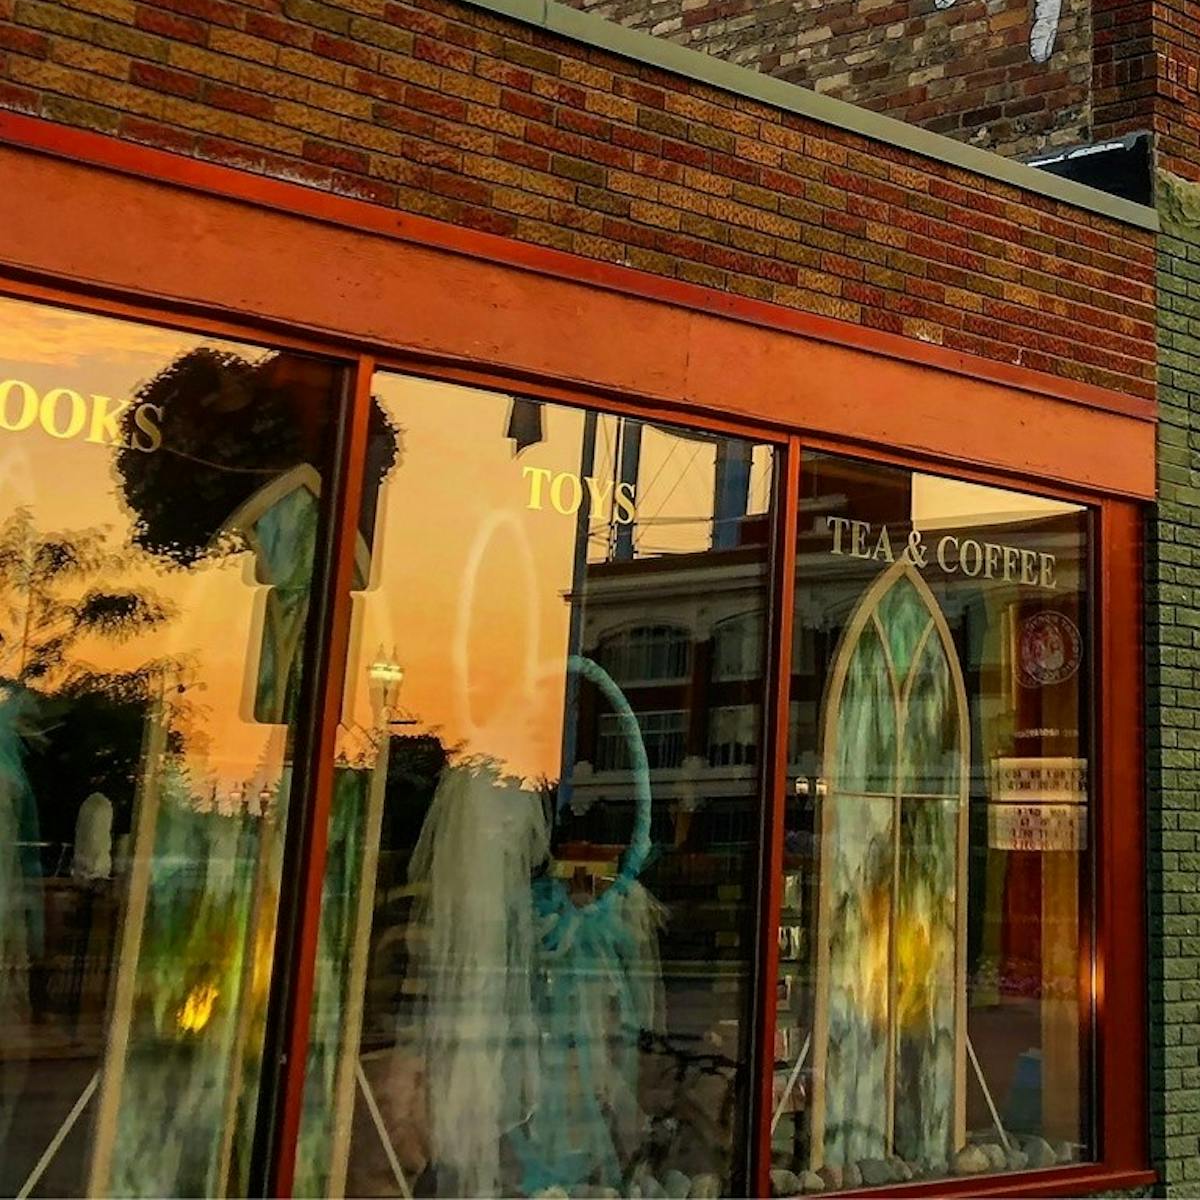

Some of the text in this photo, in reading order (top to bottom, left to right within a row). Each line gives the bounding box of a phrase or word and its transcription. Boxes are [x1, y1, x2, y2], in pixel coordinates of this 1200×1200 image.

[522, 465, 636, 525] TOYS
[826, 515, 1058, 589] TEA & COFFEE
